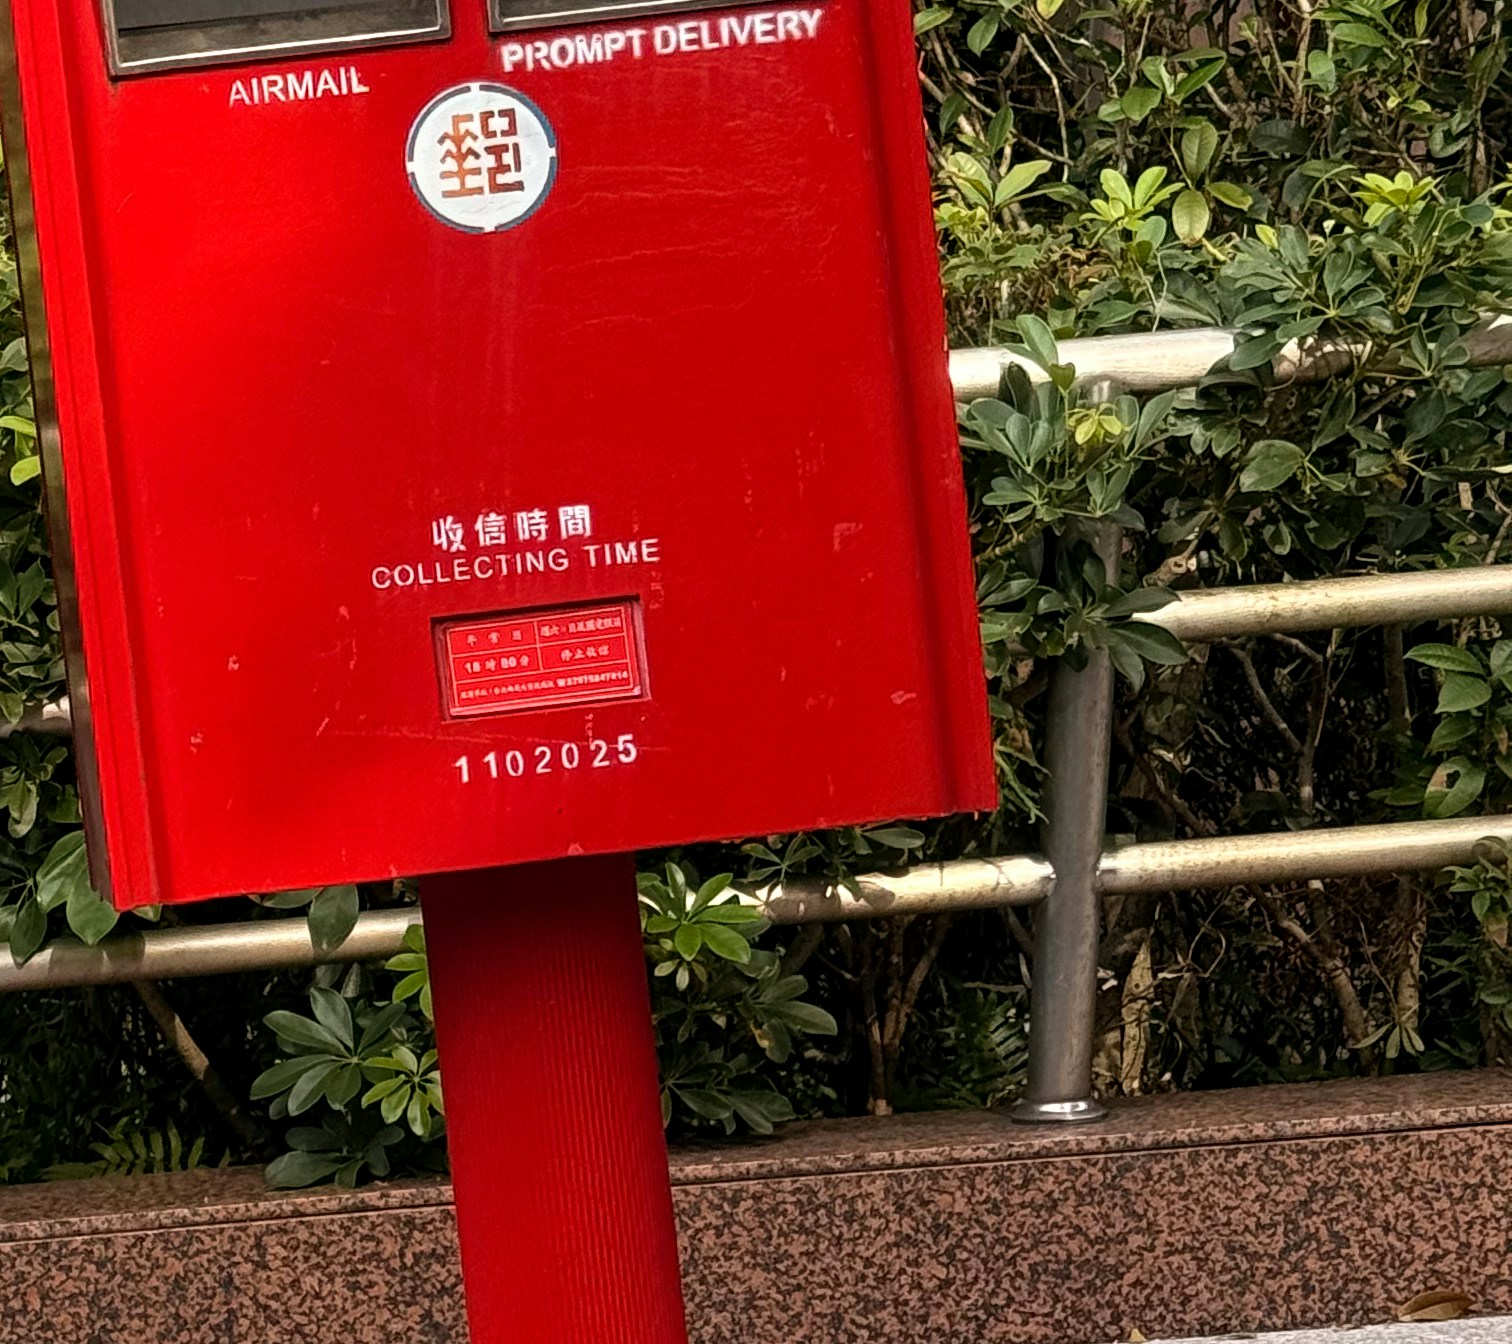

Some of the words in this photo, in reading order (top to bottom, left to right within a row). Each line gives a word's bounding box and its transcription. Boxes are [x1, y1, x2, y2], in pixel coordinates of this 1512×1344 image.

[500, 27, 648, 73] PROMPT
[652, 8, 823, 55] DELIVERY
[229, 66, 370, 106] AIRMAIL
[433, 504, 592, 552] 收信時間
[372, 548, 568, 589] COLLECTING
[583, 538, 660, 567] TIME
[455, 733, 637, 783] 1102025
